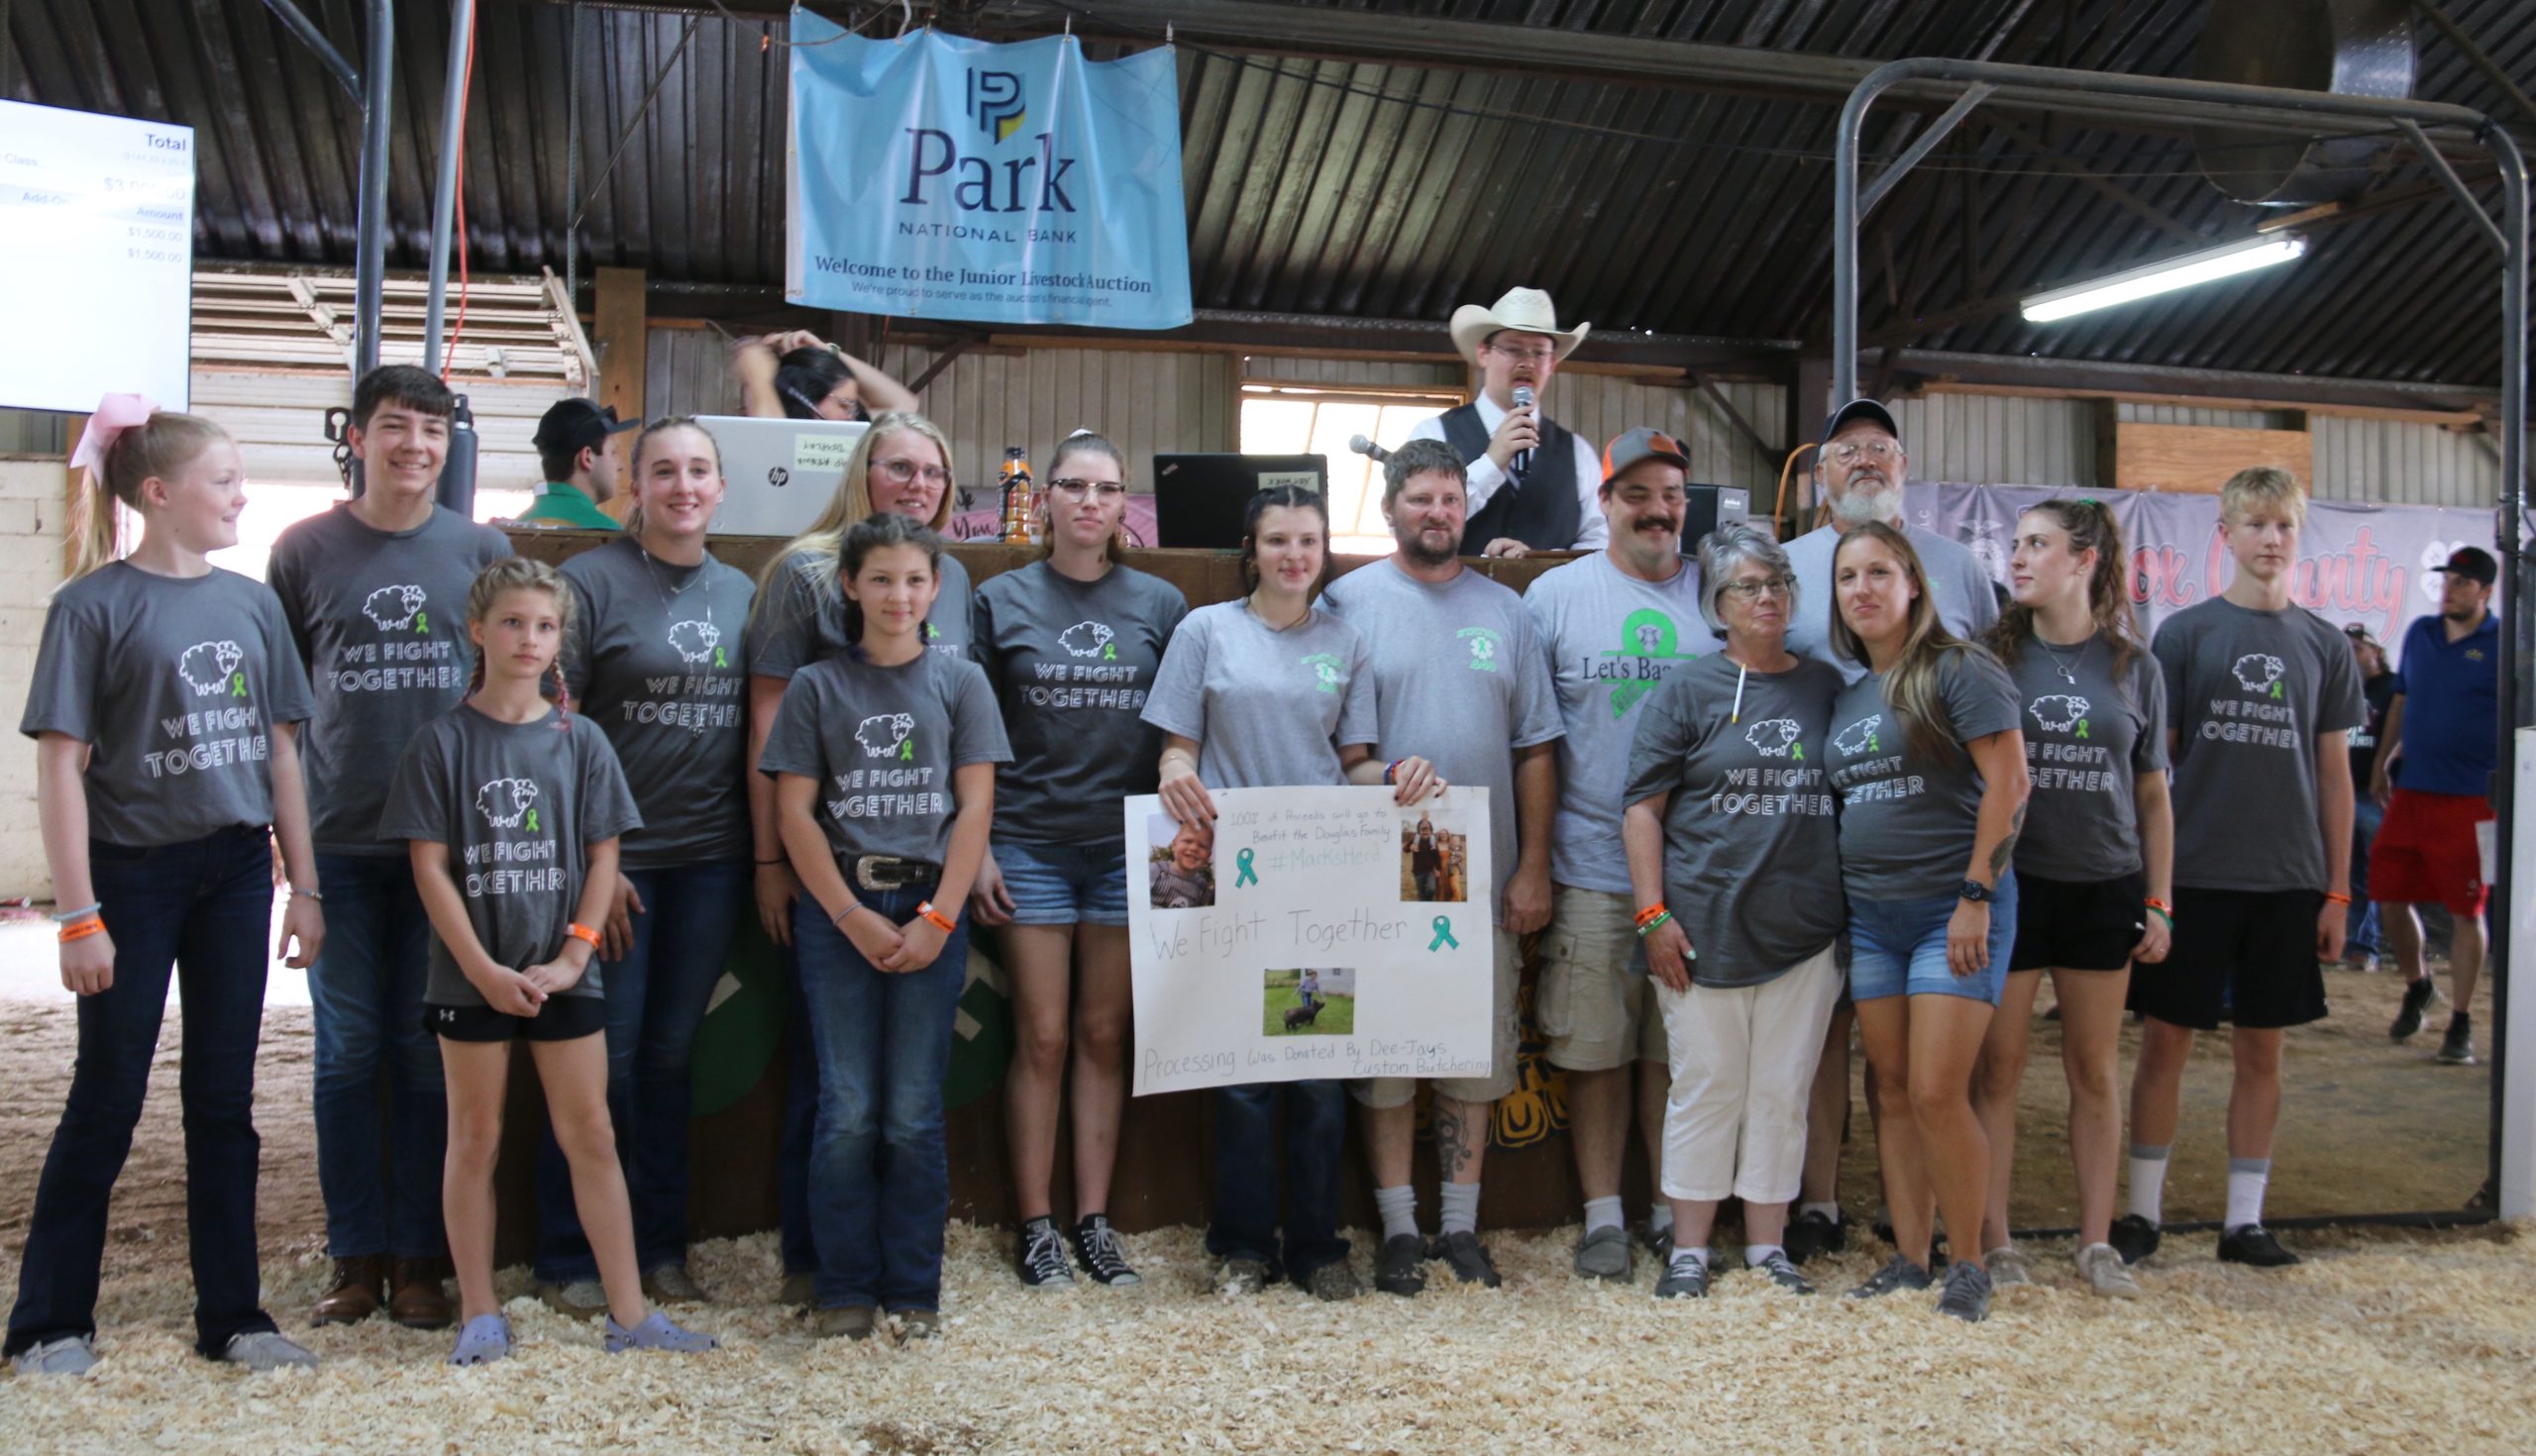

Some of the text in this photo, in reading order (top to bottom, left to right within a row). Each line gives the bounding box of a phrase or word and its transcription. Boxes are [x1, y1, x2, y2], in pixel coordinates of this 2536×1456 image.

[145, 133, 186, 151] Total
[899, 128, 1077, 213] Park
[136, 206, 183, 221] Amount
[898, 222, 1077, 244] NATIONAL BANK
[814, 256, 1151, 293] Welcome to the Junior Livestock Auction
[852, 281, 885, 295] We're
[886, 286, 919, 298] proud
[921, 288, 932, 298] to
[935, 291, 967, 301] serve
[970, 292, 983, 301] as
[985, 291, 1004, 302] the
[770, 466, 789, 487] hp
[341, 641, 452, 663] WE FIGHT
[1034, 663, 1138, 682] WE FIGHT
[1582, 655, 1630, 679] Let's
[327, 666, 462, 691] TOGETHER
[645, 676, 743, 695] WE FIGHT
[1018, 684, 1146, 709] TOGETHER
[2210, 697, 2239, 716] WE
[161, 706, 257, 739] WE FIGH
[144, 735, 267, 779] TOGETHE
[2026, 742, 2107, 764] E FIGHT
[870, 768, 933, 787] FIGHT
[1725, 768, 1823, 787] WE FIGHT
[1849, 756, 1902, 779] FIGHT
[2028, 766, 2114, 791] GETHER
[1332, 809, 1351, 819] will
[1356, 811, 1369, 823] go
[1374, 807, 1387, 818] to
[1711, 793, 1834, 816] TOGETHER
[1252, 824, 1391, 844] Benefit the Douglas Family
[464, 840, 557, 865] WE FIGHT
[1149, 907, 1409, 960] We Fight Together
[1143, 1048, 1235, 1088] Processing
[1285, 1043, 1335, 1061] Donated
[1346, 1042, 1360, 1061] By
[1370, 1039, 1447, 1058] Dee-Jays
[1352, 1056, 1490, 1077] Custom Butchering
